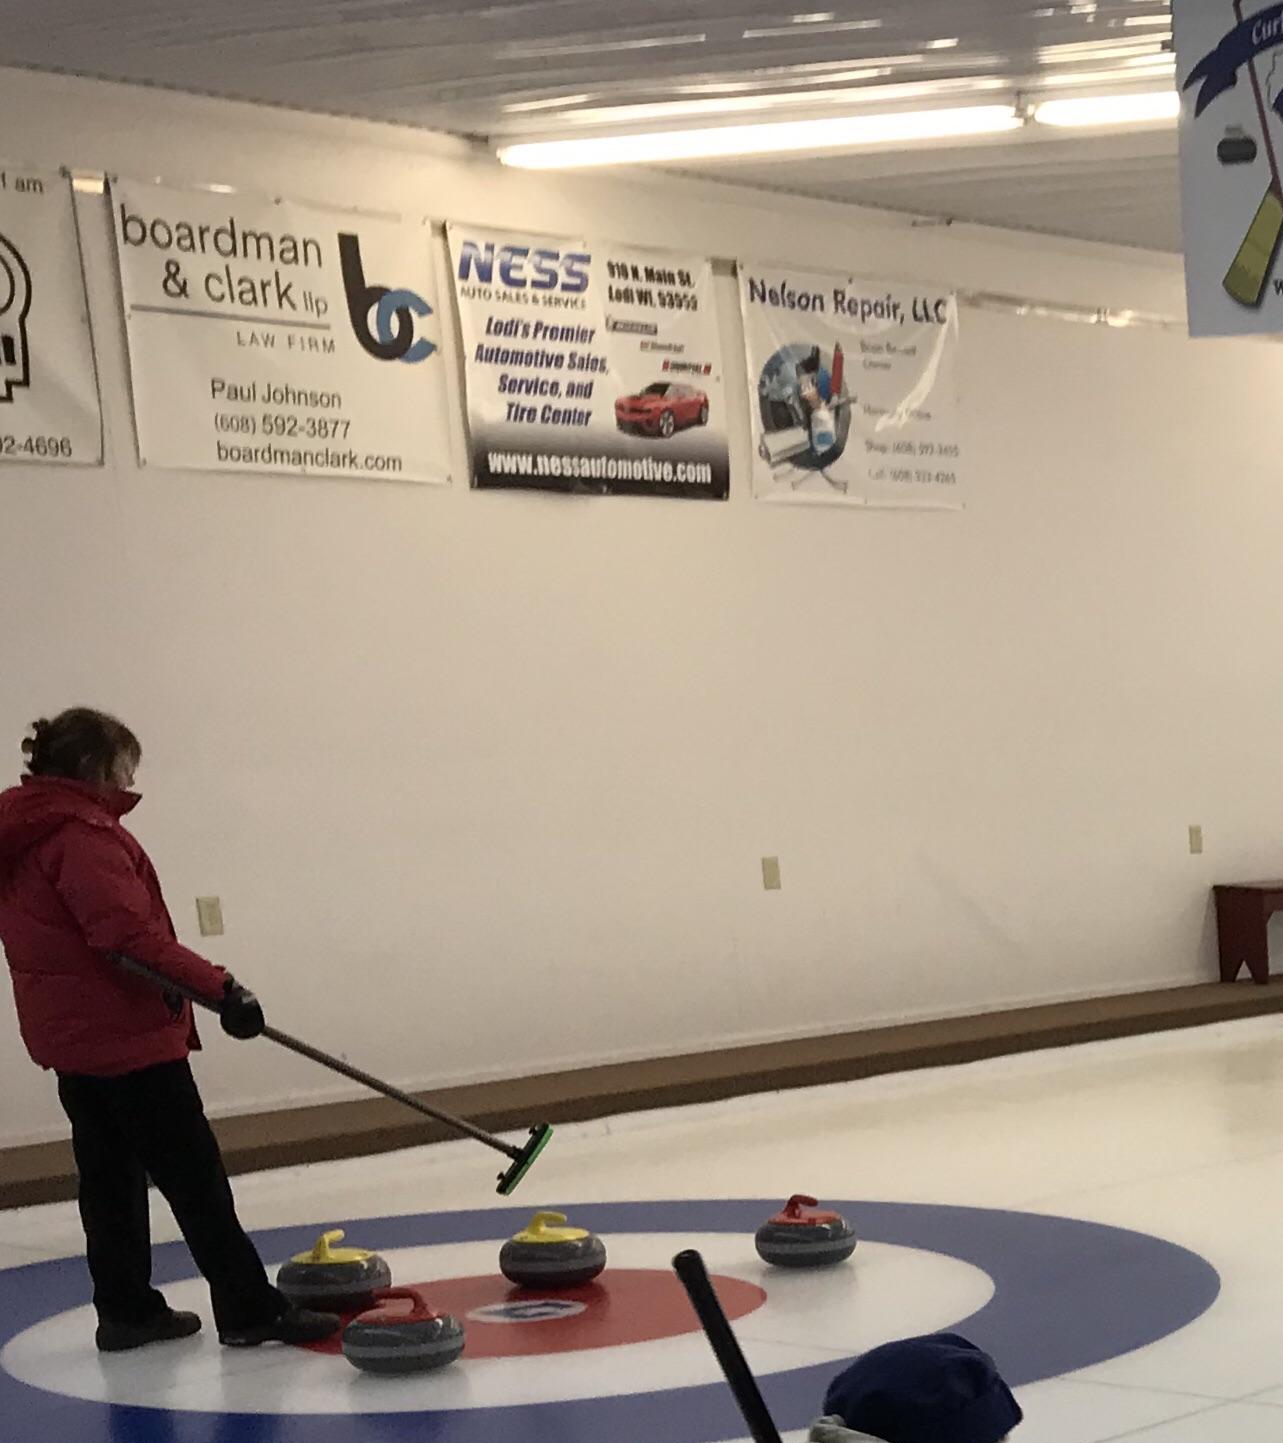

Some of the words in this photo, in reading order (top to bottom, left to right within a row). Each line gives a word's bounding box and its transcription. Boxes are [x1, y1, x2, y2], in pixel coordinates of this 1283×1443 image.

[14, 176, 44, 194] am
[120, 203, 323, 268] boardman
[458, 239, 592, 294] NESS
[644, 265, 676, 287] Main
[161, 257, 190, 300] &
[204, 262, 297, 312] clark
[302, 289, 329, 319] llp
[460, 286, 492, 300] AUTO
[495, 289, 529, 305] SALES
[541, 293, 586, 310] SERVICE
[607, 283, 635, 305] Lodi
[748, 275, 825, 313] Nelson
[832, 287, 905, 325] Repair,
[911, 295, 948, 325] LLC
[236, 330, 276, 349] LAW
[287, 333, 336, 355] FIRM
[485, 315, 531, 340] Lodi's
[532, 320, 596, 345] Premier
[474, 343, 565, 370] Automotive
[567, 350, 609, 377] Sales,
[211, 376, 257, 403] Paul
[261, 381, 342, 410] Johnson
[497, 372, 562, 400] Service,
[565, 379, 595, 400] and
[213, 412, 257, 436] (608)
[262, 413, 351, 440] 592-3877
[505, 401, 538, 424] Tire
[540, 403, 593, 428] Center
[216, 439, 402, 472] boardmanclark.com
[487, 451, 712, 484] www.nessautomotive.com
